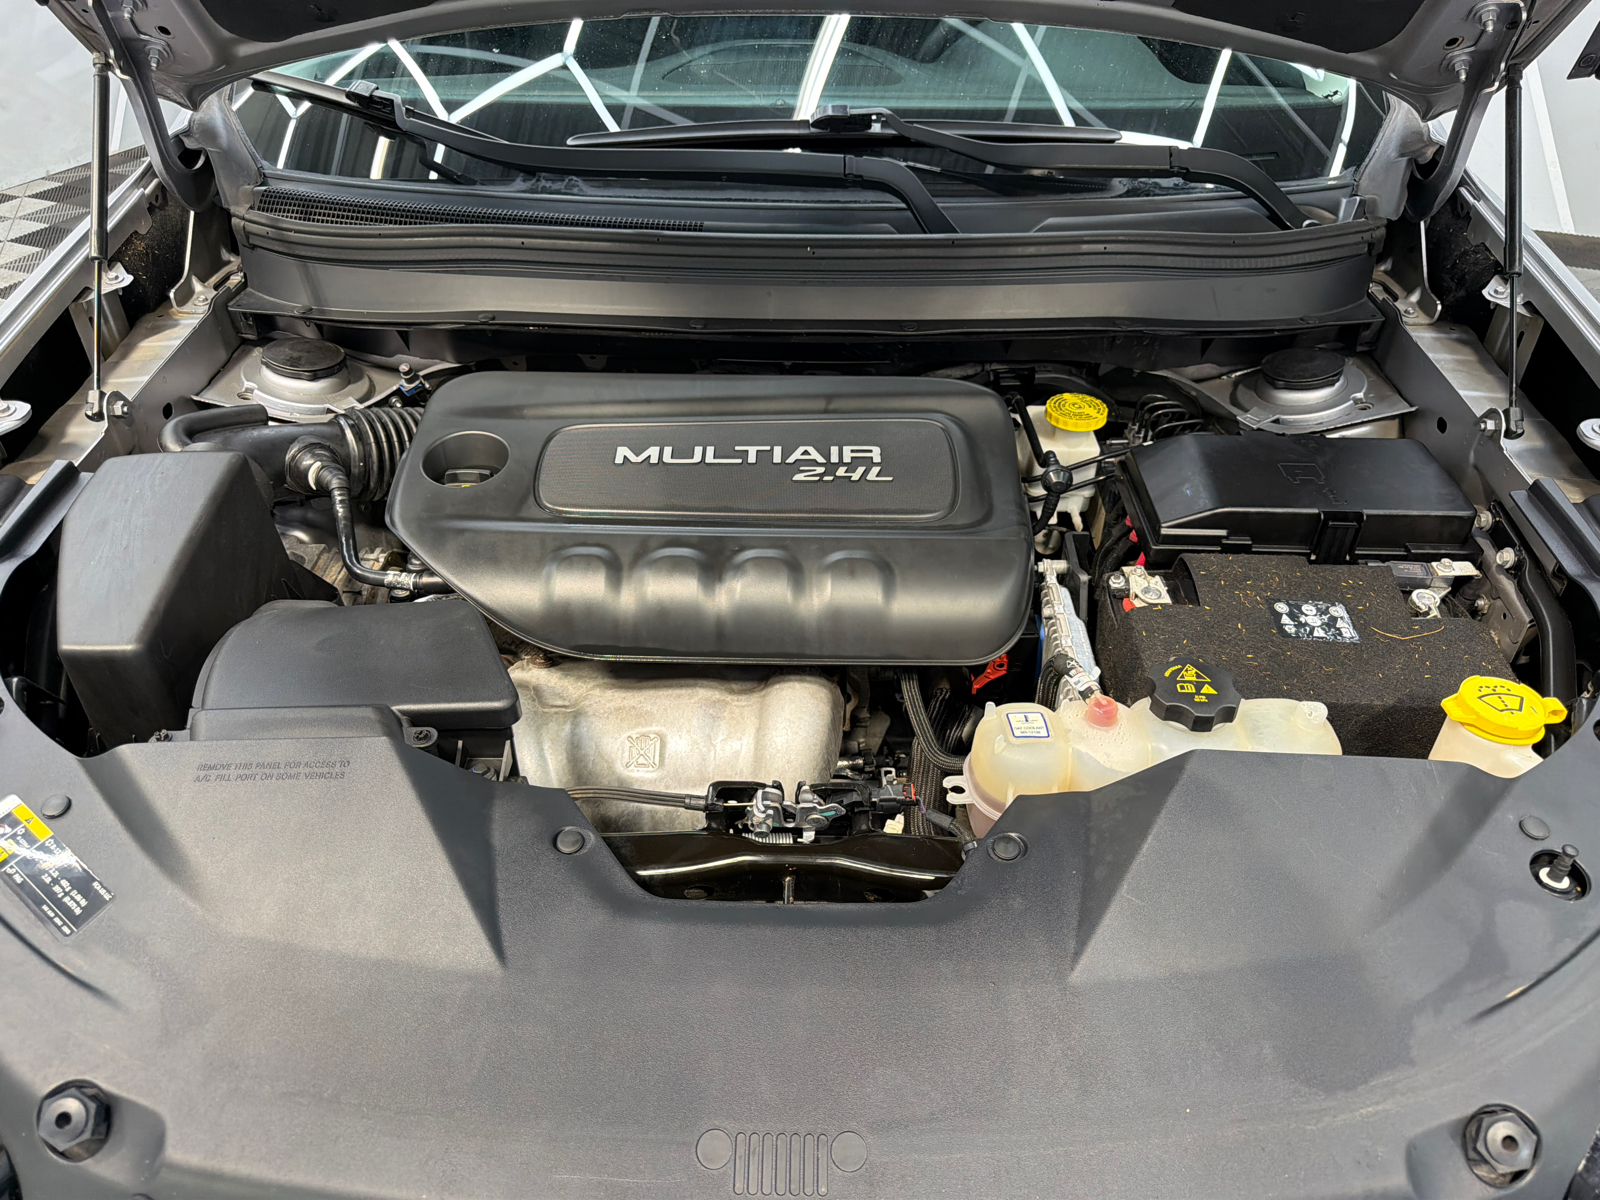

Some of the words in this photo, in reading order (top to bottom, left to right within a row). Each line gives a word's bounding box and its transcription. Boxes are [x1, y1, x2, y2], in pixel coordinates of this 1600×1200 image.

[614, 445, 882, 464] MULTIAIR
[792, 466, 894, 481] 2.4L
[196, 763, 232, 772] REMOVE
[234, 762, 253, 770] THIS
[254, 762, 282, 770] PANEL
[284, 761, 301, 769] FOR
[303, 761, 336, 769] ACCESS
[337, 760, 350, 768] TO
[193, 774, 212, 783] A/C
[214, 774, 232, 782] FILL
[235, 773, 258, 782] PORT
[260, 773, 274, 781] ON
[275, 772, 301, 780] SOME
[304, 771, 345, 780] VEHICLES
